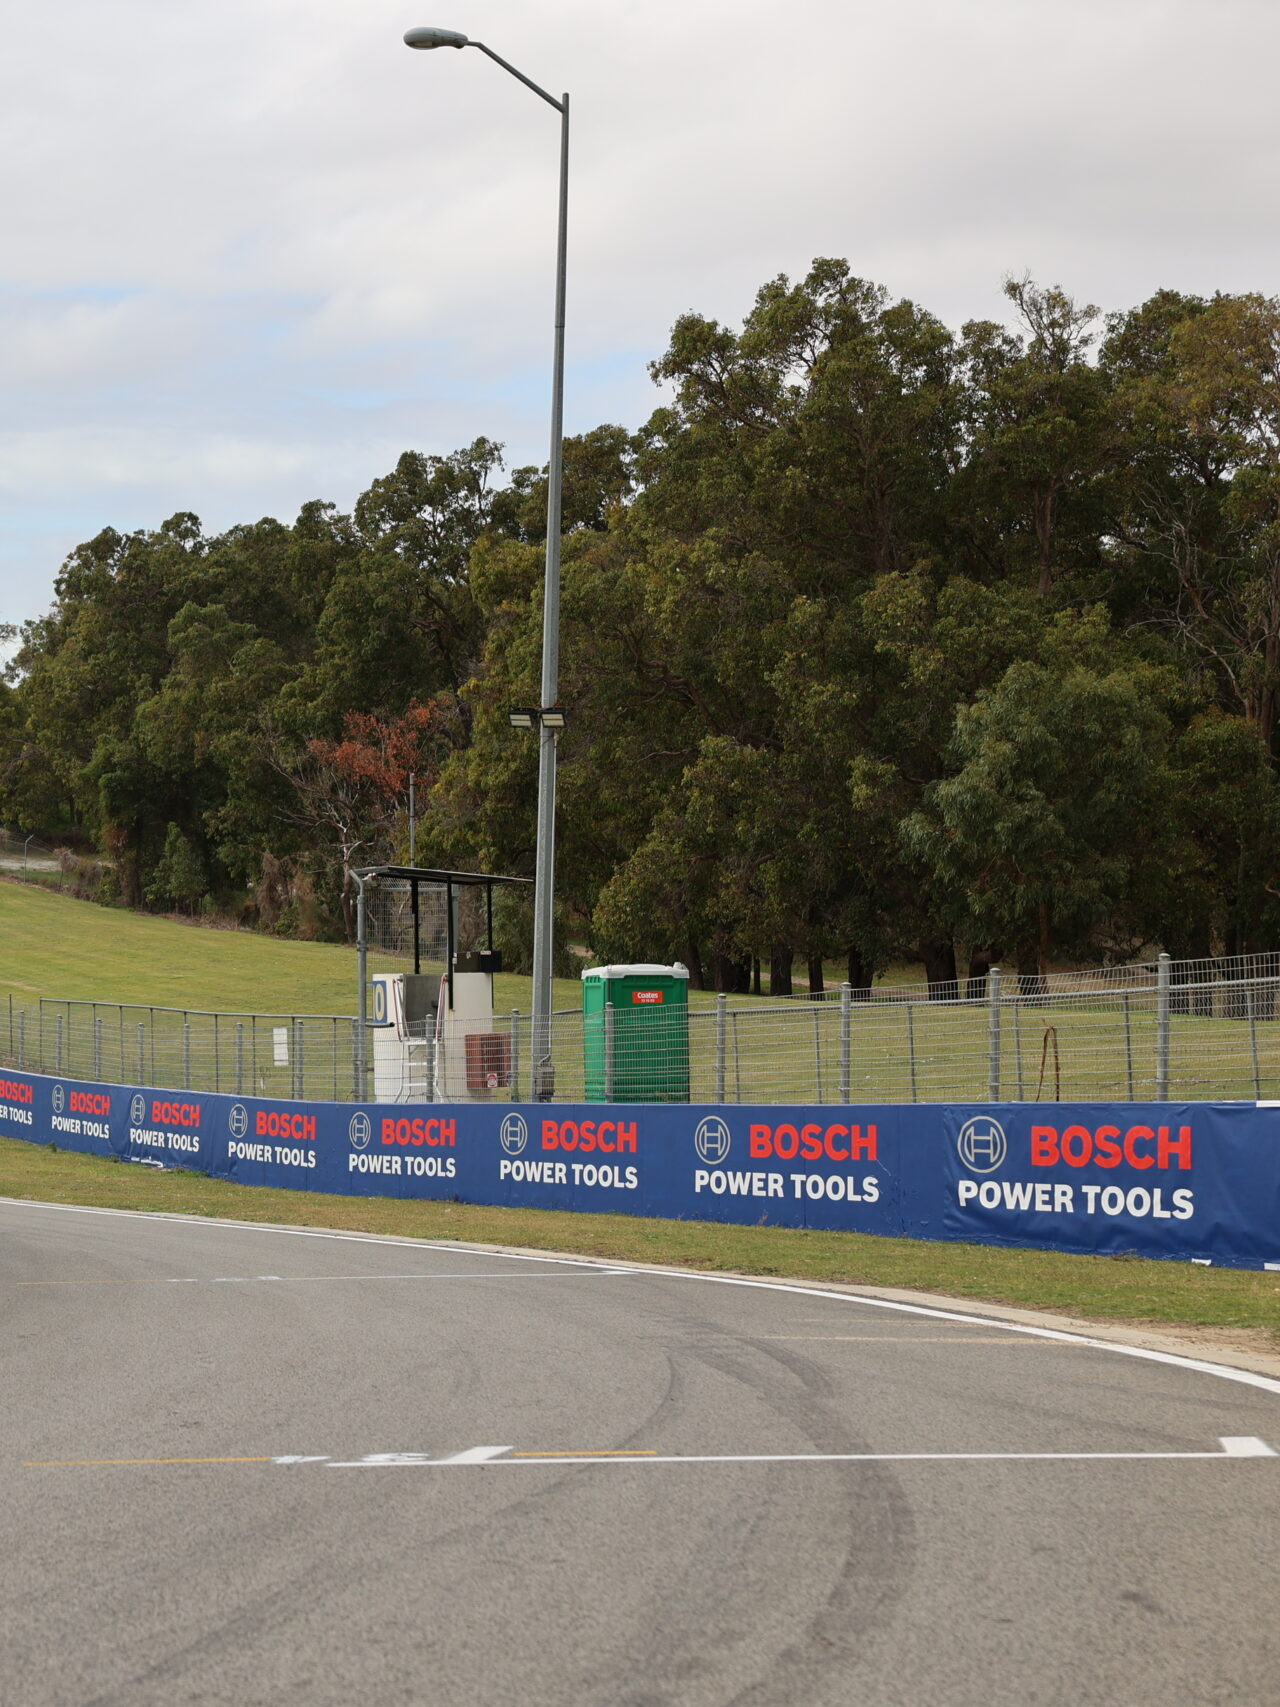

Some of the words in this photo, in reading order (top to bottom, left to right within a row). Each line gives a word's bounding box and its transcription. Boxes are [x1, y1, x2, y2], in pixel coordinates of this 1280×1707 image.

[9, 1107, 33, 1125] TOOLS
[70, 1091, 111, 1115] BOSCH
[152, 1100, 200, 1127] BOSCH
[51, 1115, 81, 1134] POWER
[82, 1120, 110, 1139] TOOLS
[130, 1128, 165, 1148] POWER
[167, 1133, 200, 1152] TOOLS
[256, 1111, 316, 1140] BOSCH
[381, 1118, 456, 1147] BOSCH
[541, 1120, 637, 1153] BOSCH
[228, 1141, 272, 1163] POWER
[275, 1147, 316, 1168] TOOLS
[750, 1123, 877, 1161] BOSCH
[1031, 1125, 1192, 1170] BOSCH
[348, 1153, 401, 1175] POWER
[404, 1156, 456, 1178] TOOLS
[499, 1159, 567, 1184] POWER
[571, 1163, 638, 1189] TOOLS
[695, 1170, 784, 1197] POWER
[790, 1174, 880, 1202] TOOLS
[958, 1180, 1074, 1213] POWER
[1081, 1185, 1194, 1220] TOOLS
